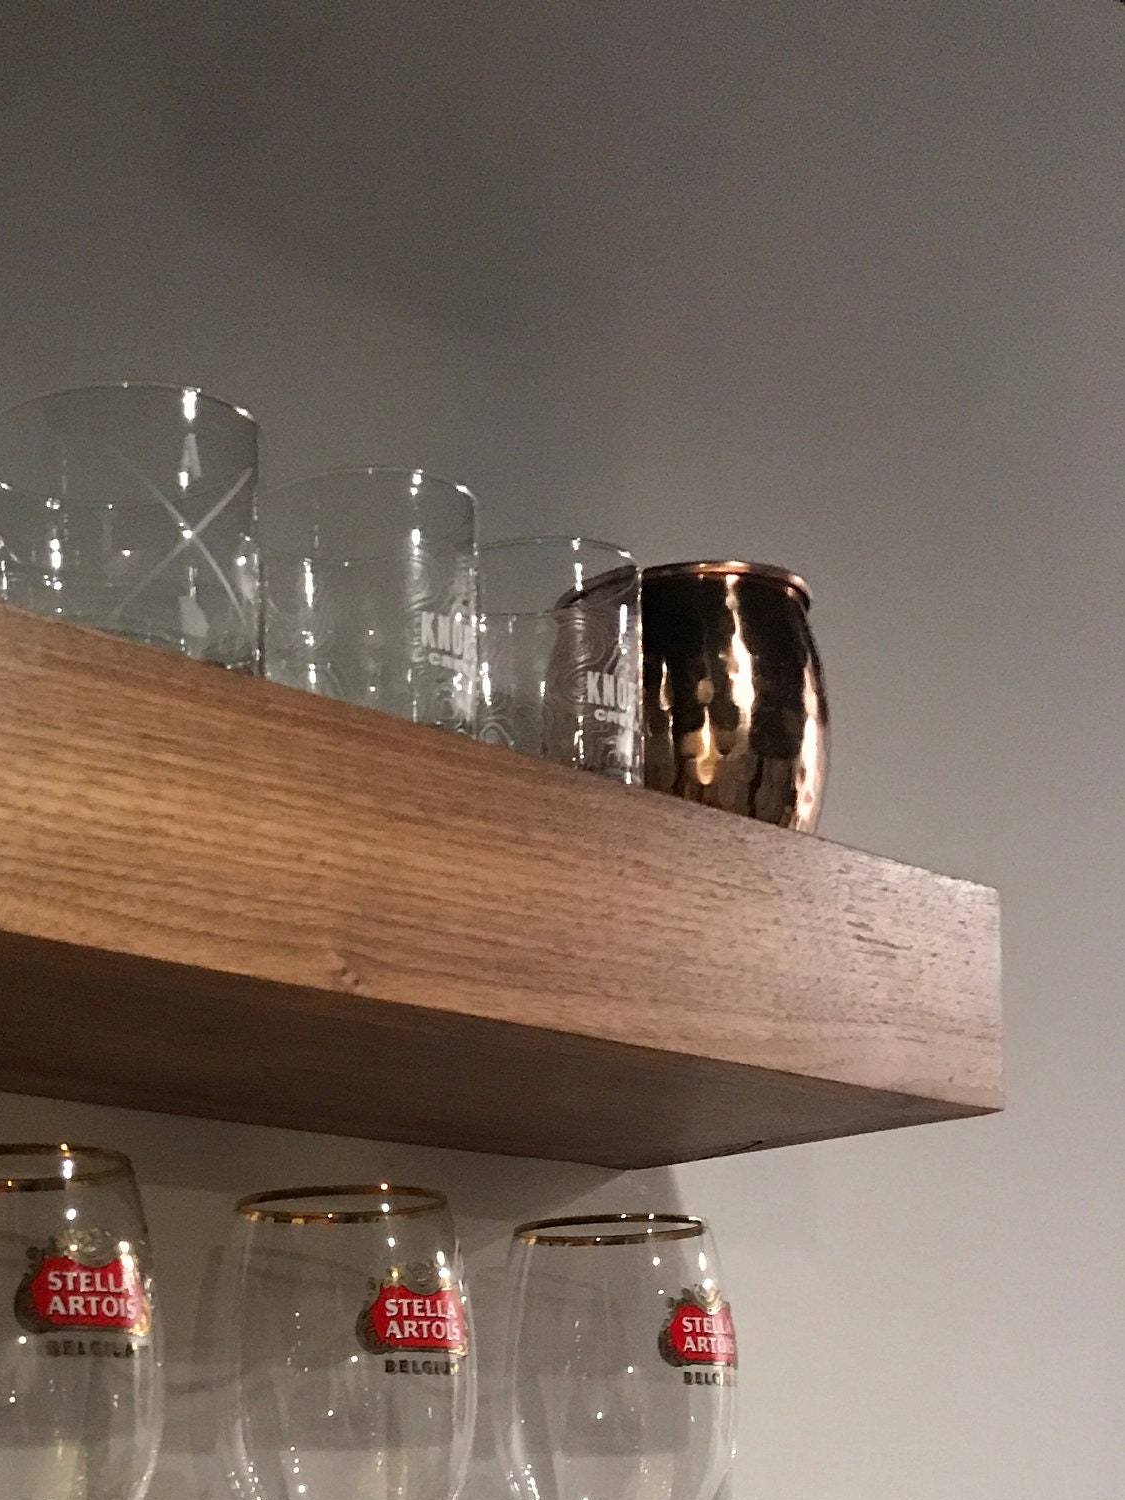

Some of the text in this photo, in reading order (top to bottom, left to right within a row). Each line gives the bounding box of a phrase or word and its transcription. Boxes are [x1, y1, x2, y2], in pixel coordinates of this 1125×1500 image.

[47, 1270, 135, 1295] STELLA
[48, 1296, 136, 1319] ARTOIS
[384, 1299, 458, 1319] STELLA
[385, 1320, 460, 1340] ARTOIS
